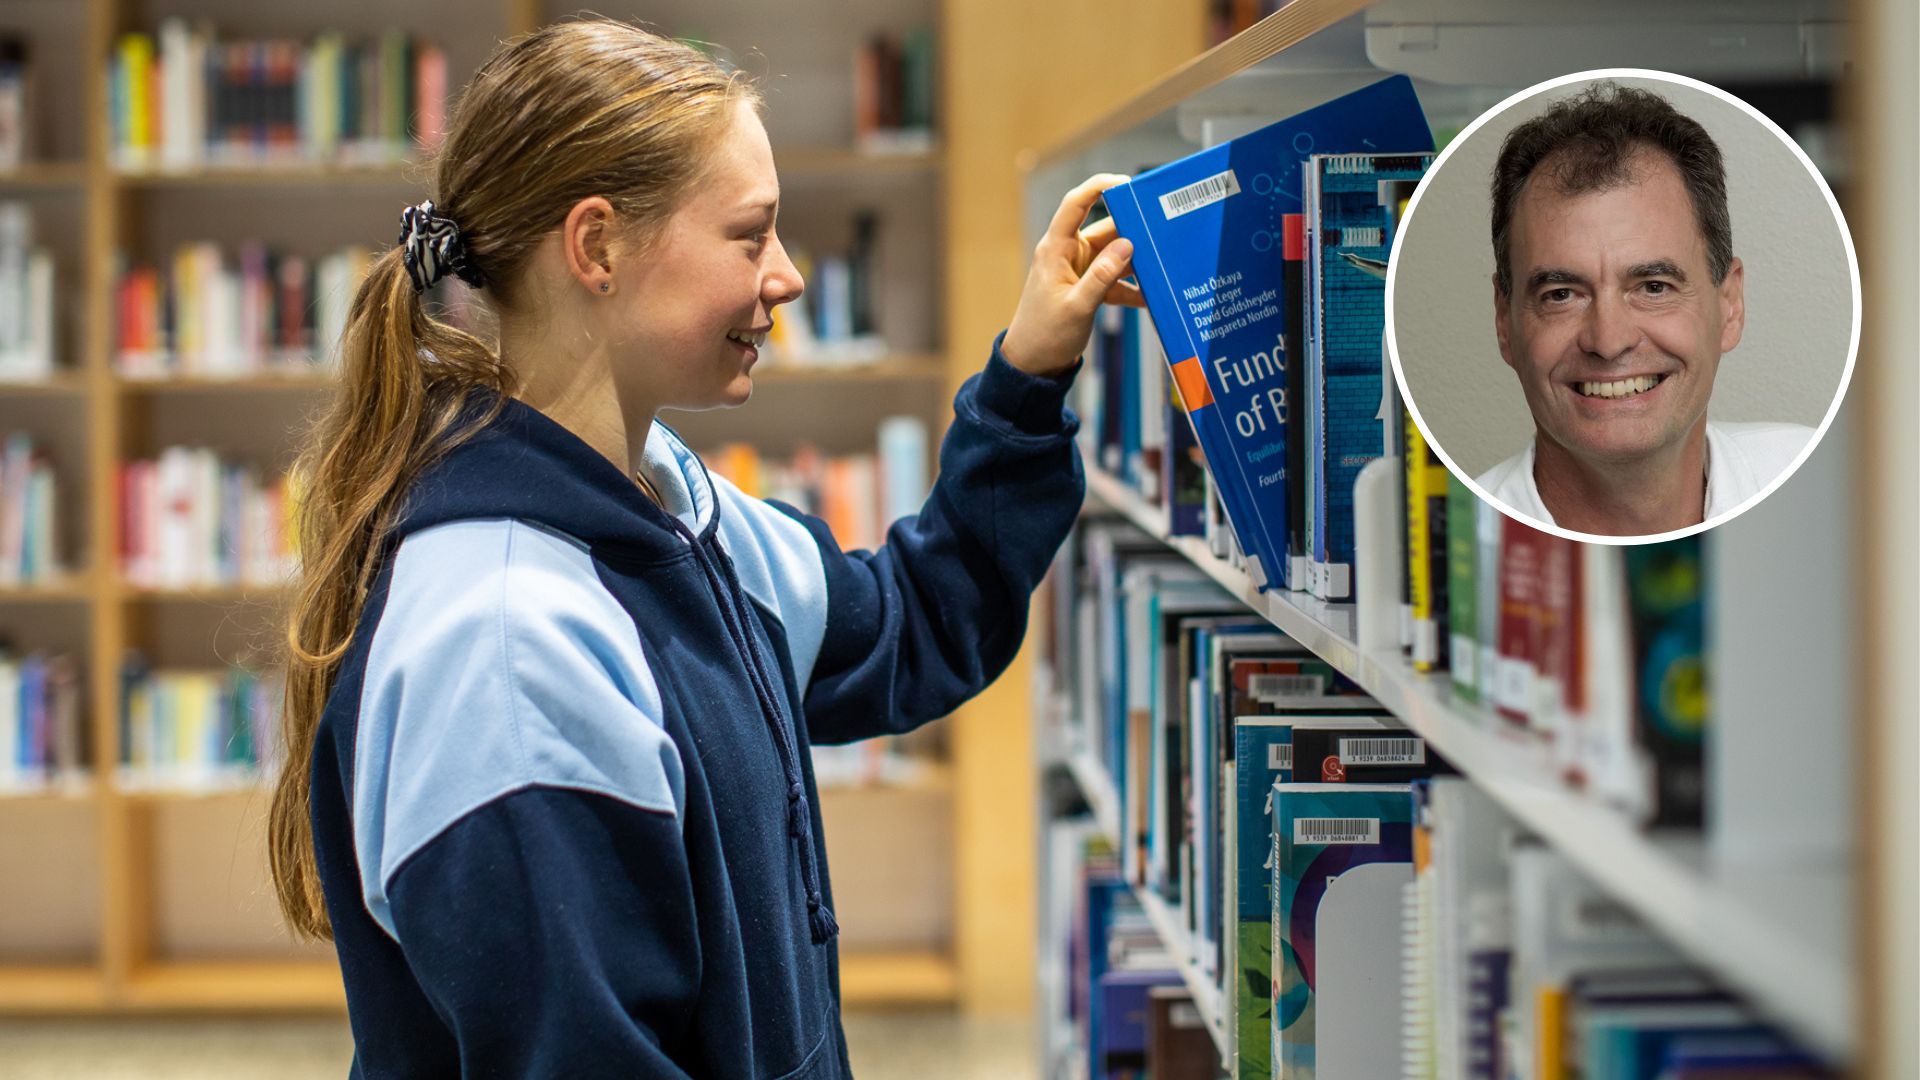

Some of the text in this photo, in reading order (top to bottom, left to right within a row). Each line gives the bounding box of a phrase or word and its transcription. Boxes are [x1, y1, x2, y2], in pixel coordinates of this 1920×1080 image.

[1183, 271, 1242, 300] Nihat Özkaya
[1188, 287, 1242, 315] Dawn Leger
[1194, 289, 1277, 328] David Goldsheyder
[1200, 305, 1279, 342] Margareta Nordin
[1236, 394, 1266, 437] of
[1343, 456, 1376, 465] SECON
